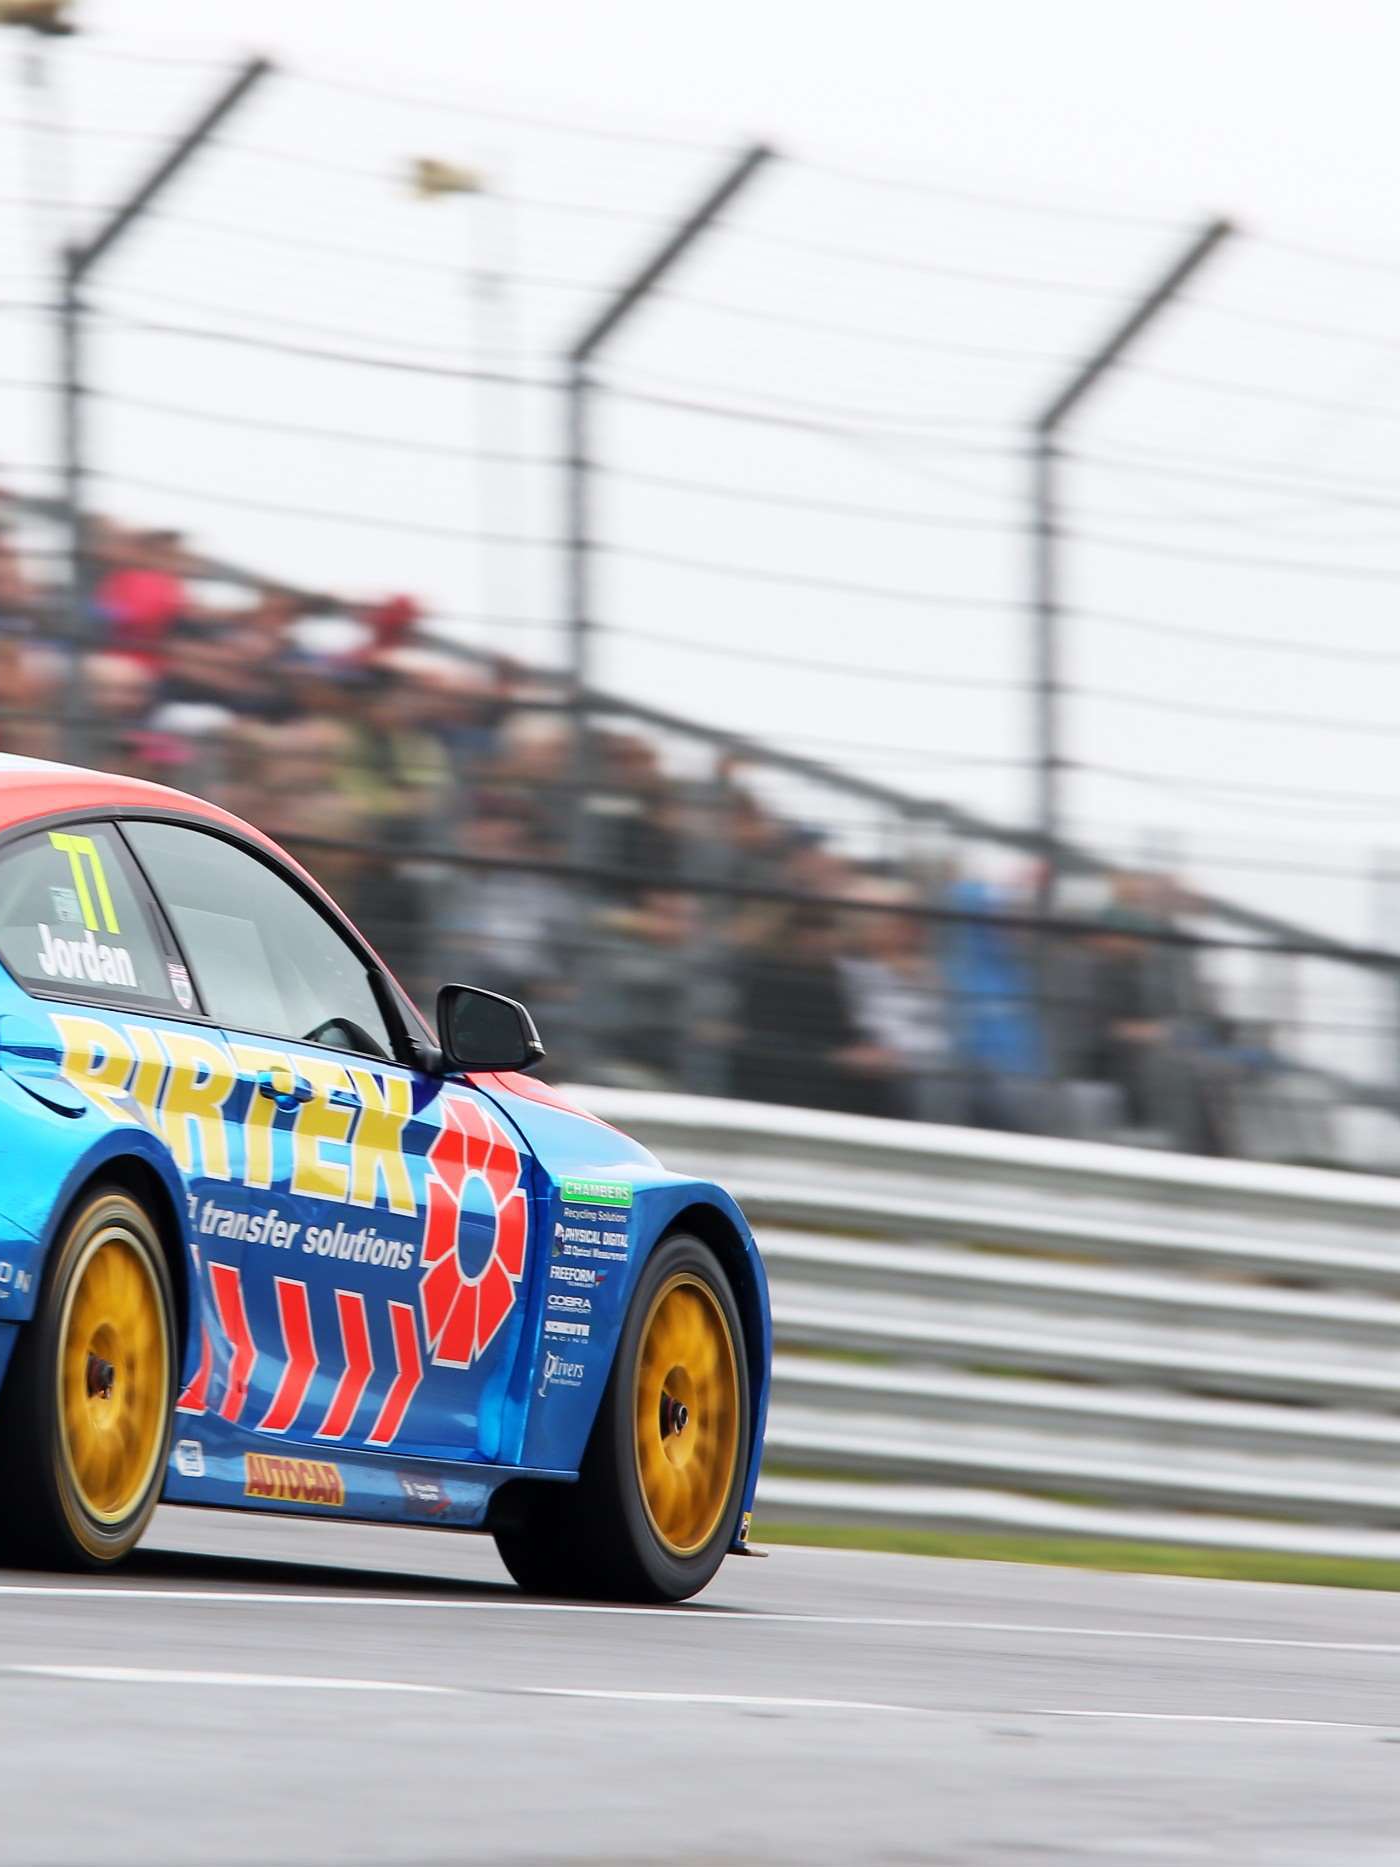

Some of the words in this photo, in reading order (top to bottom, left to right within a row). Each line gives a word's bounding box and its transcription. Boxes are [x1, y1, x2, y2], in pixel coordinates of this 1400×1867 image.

[48, 831, 111, 935] 77
[37, 922, 138, 988] Jordan
[49, 1013, 418, 1218] PIRTEK
[564, 1181, 631, 1202] CHAMBERS
[563, 1207, 597, 1221] Recycling
[598, 1210, 628, 1224] Solutions
[200, 1199, 301, 1250] transfer
[302, 1222, 416, 1271] solutions
[564, 1227, 601, 1245] PHYSICAL
[603, 1231, 629, 1248] DIGITAL
[550, 1265, 596, 1283] FREEFORM
[547, 1294, 592, 1309] COBRA
[544, 1334, 589, 1344] RACING
[247, 1454, 342, 1505] AUTOCAR
